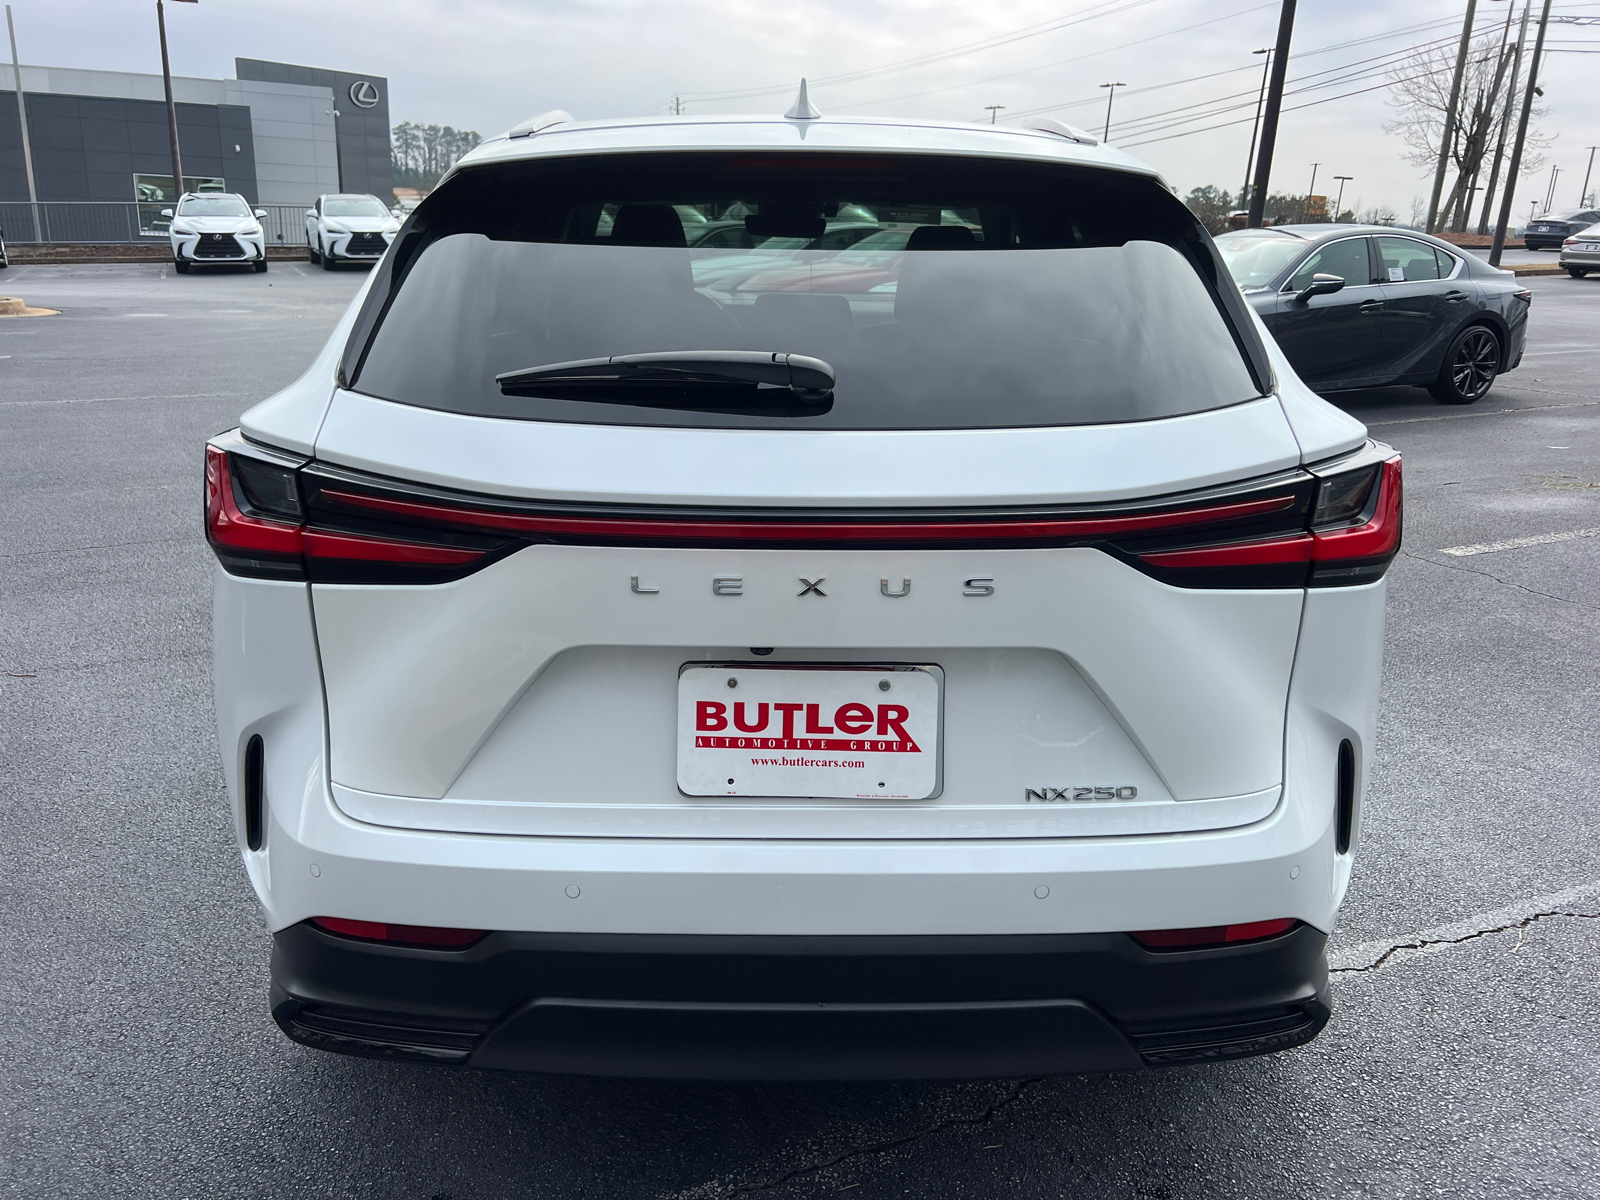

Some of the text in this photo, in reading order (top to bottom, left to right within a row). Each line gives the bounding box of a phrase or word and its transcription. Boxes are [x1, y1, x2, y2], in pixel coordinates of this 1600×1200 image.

[630, 574, 995, 598] LEXUS
[696, 737, 914, 751] AUTOMOTIVE GROUP
[751, 757, 866, 769] www.butlercars.com
